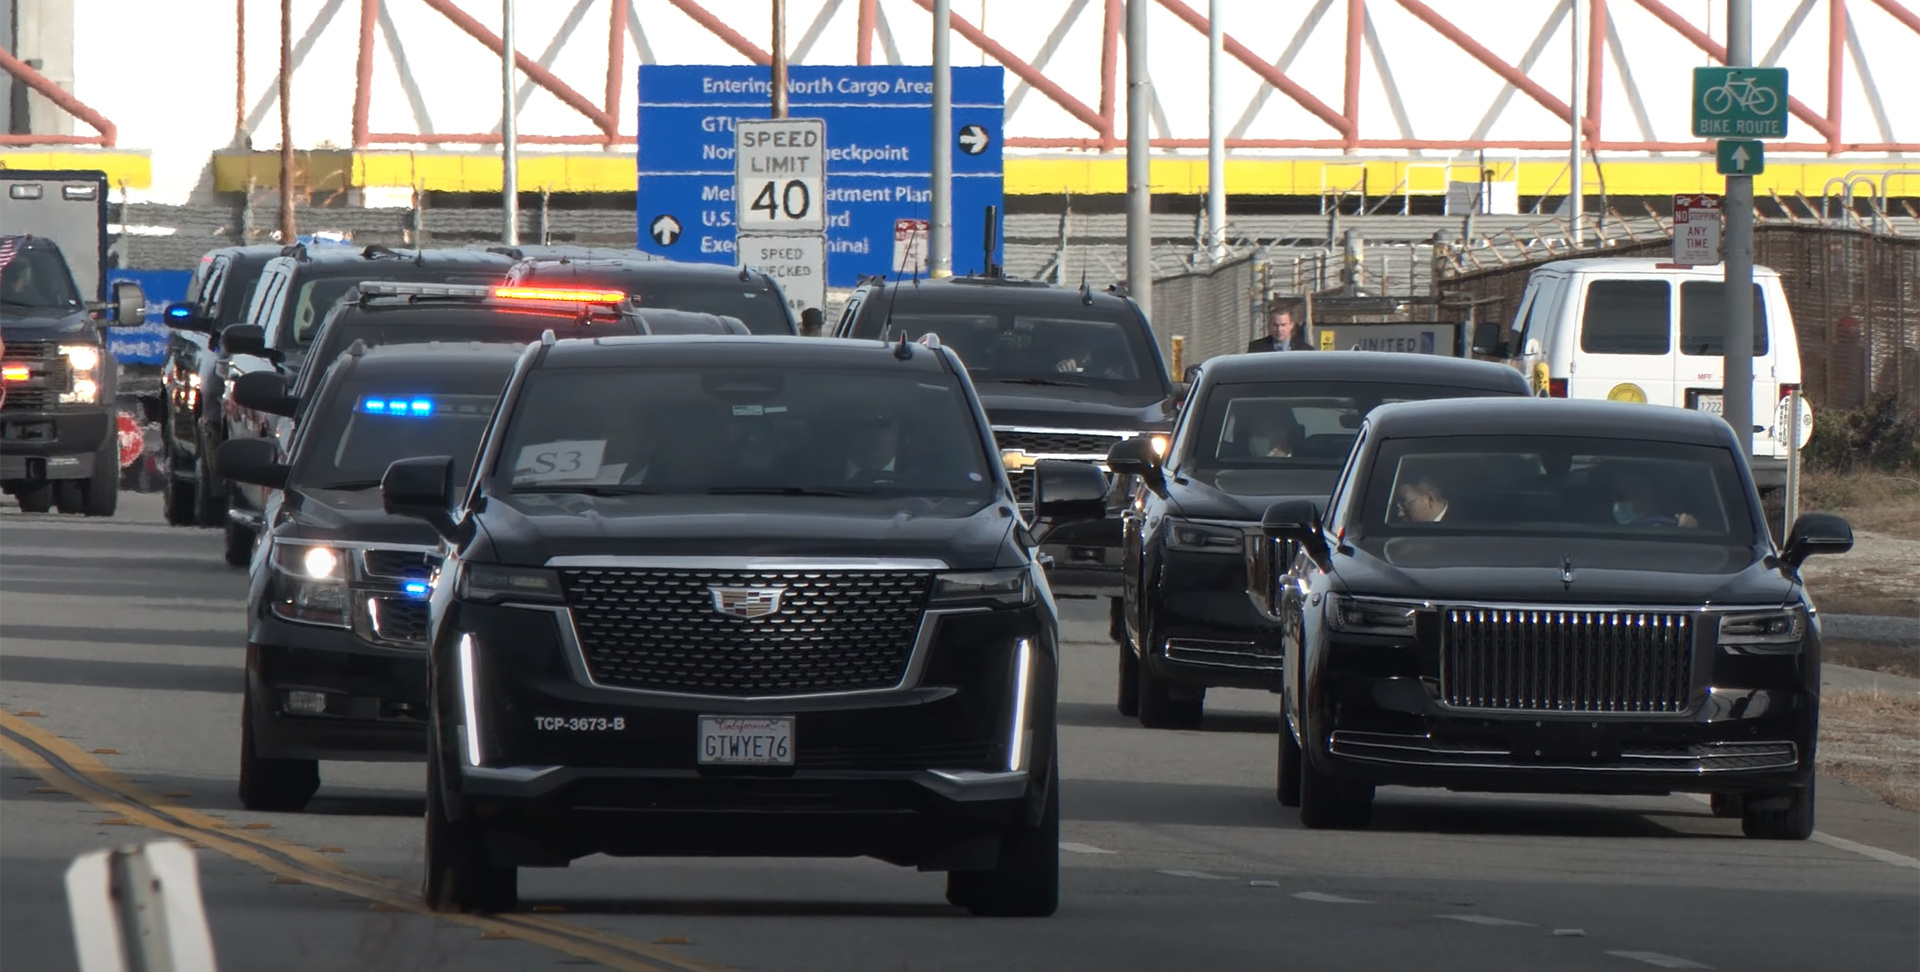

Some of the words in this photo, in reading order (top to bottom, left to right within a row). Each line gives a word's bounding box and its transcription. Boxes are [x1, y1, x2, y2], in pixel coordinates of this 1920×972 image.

[702, 78, 773, 98] Entering
[837, 78, 890, 97] Cargo
[894, 78, 933, 94] Area
[1701, 119, 1730, 133] BIKE
[1736, 119, 1780, 134] ROUTE
[743, 130, 817, 148] SPEED
[751, 156, 810, 173] LIMIT
[750, 180, 810, 220] 40
[1675, 210, 1688, 222] NO
[1689, 211, 1720, 222] STOPPING
[1687, 226, 1708, 237] ANY
[1686, 238, 1708, 249] TIME
[760, 248, 804, 260] SPEED
[1358, 338, 1416, 352] UNITED
[532, 450, 582, 475] S3
[535, 716, 625, 731] TCP-3673-B
[719, 719, 777, 733] California
[705, 734, 788, 758] GTWYE76
